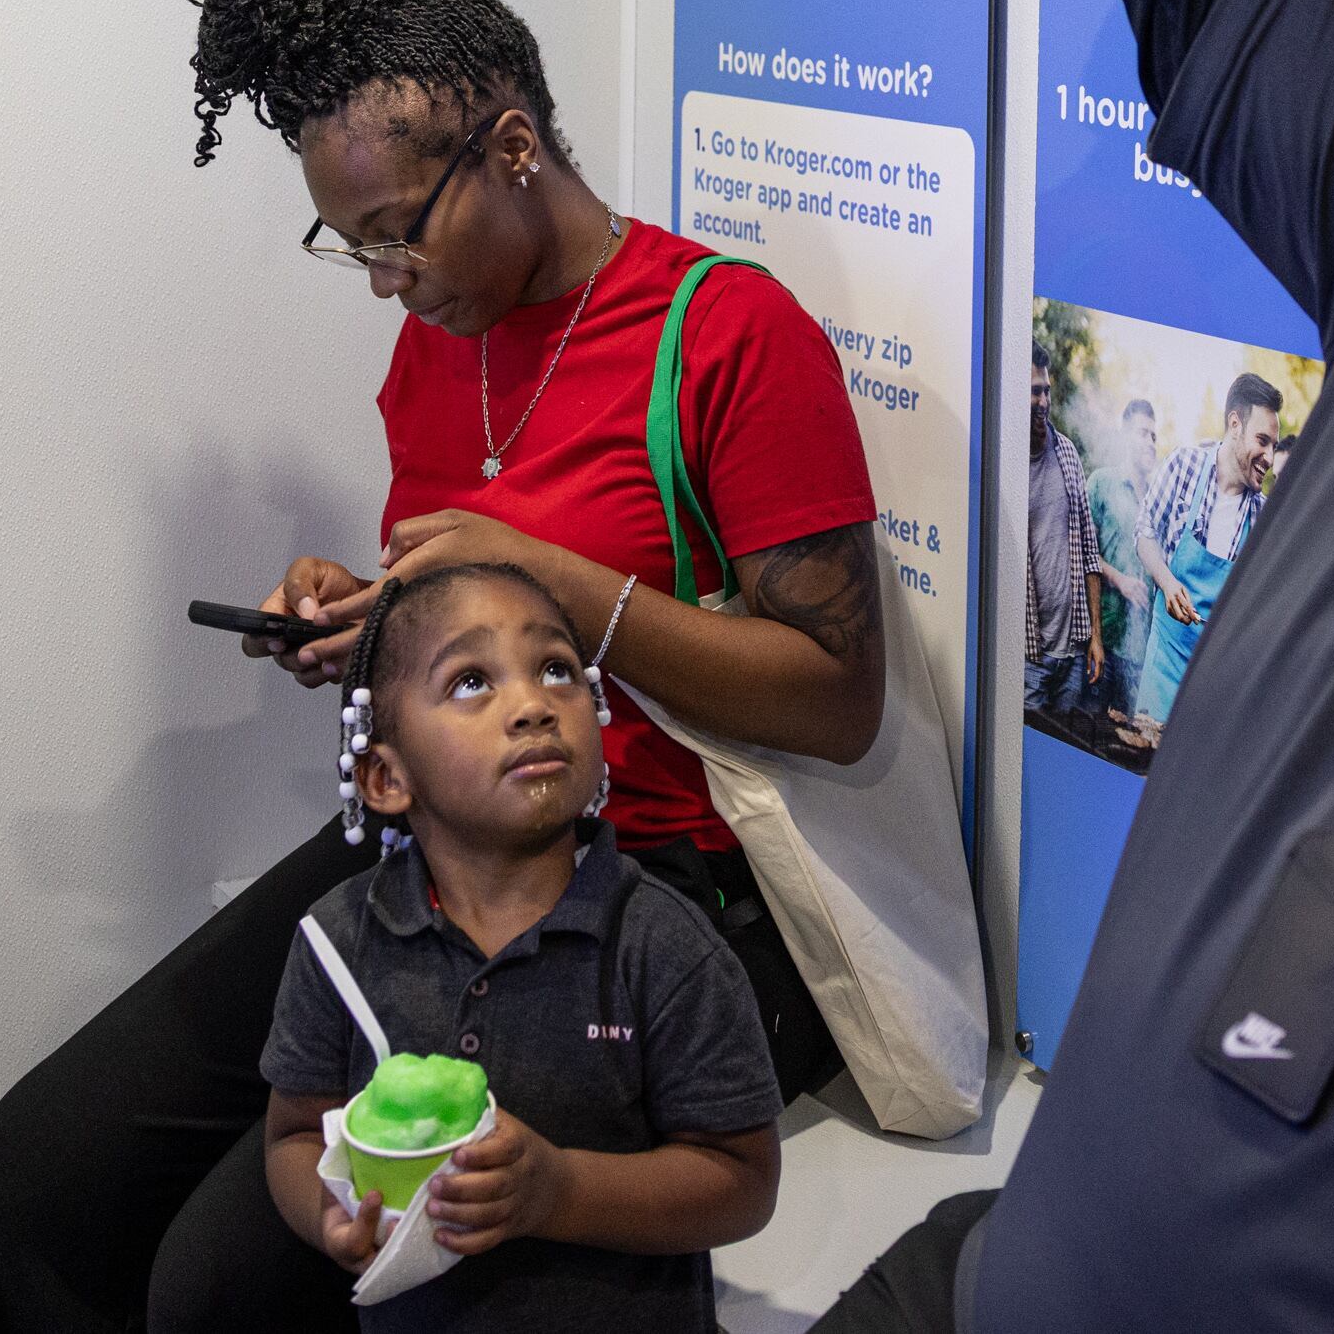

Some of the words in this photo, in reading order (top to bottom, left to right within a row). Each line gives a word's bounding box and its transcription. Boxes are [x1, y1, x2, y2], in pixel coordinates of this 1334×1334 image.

[719, 42, 766, 76] How
[772, 48, 827, 85] does
[834, 54, 850, 88] it
[858, 61, 933, 97] work?
[1057, 85, 1067, 120] 1
[1078, 86, 1149, 131] hour
[694, 127, 706, 153] 1.
[711, 131, 735, 158] Go
[740, 135, 759, 161] to
[764, 139, 872, 179] Kroger.com
[879, 164, 900, 186] or
[907, 163, 940, 194] the
[1134, 142, 1202, 198] bus
[693, 210, 766, 246] account.
[694, 167, 753, 203] Kroger
[758, 184, 792, 213] app
[798, 189, 832, 216] and
[838, 199, 901, 230] create
[908, 214, 932, 237] an
[822, 317, 875, 360] livery
[882, 335, 912, 369] zip
[850, 368, 919, 411] Kroger
[879, 509, 919, 546] sket
[927, 524, 940, 554] &
